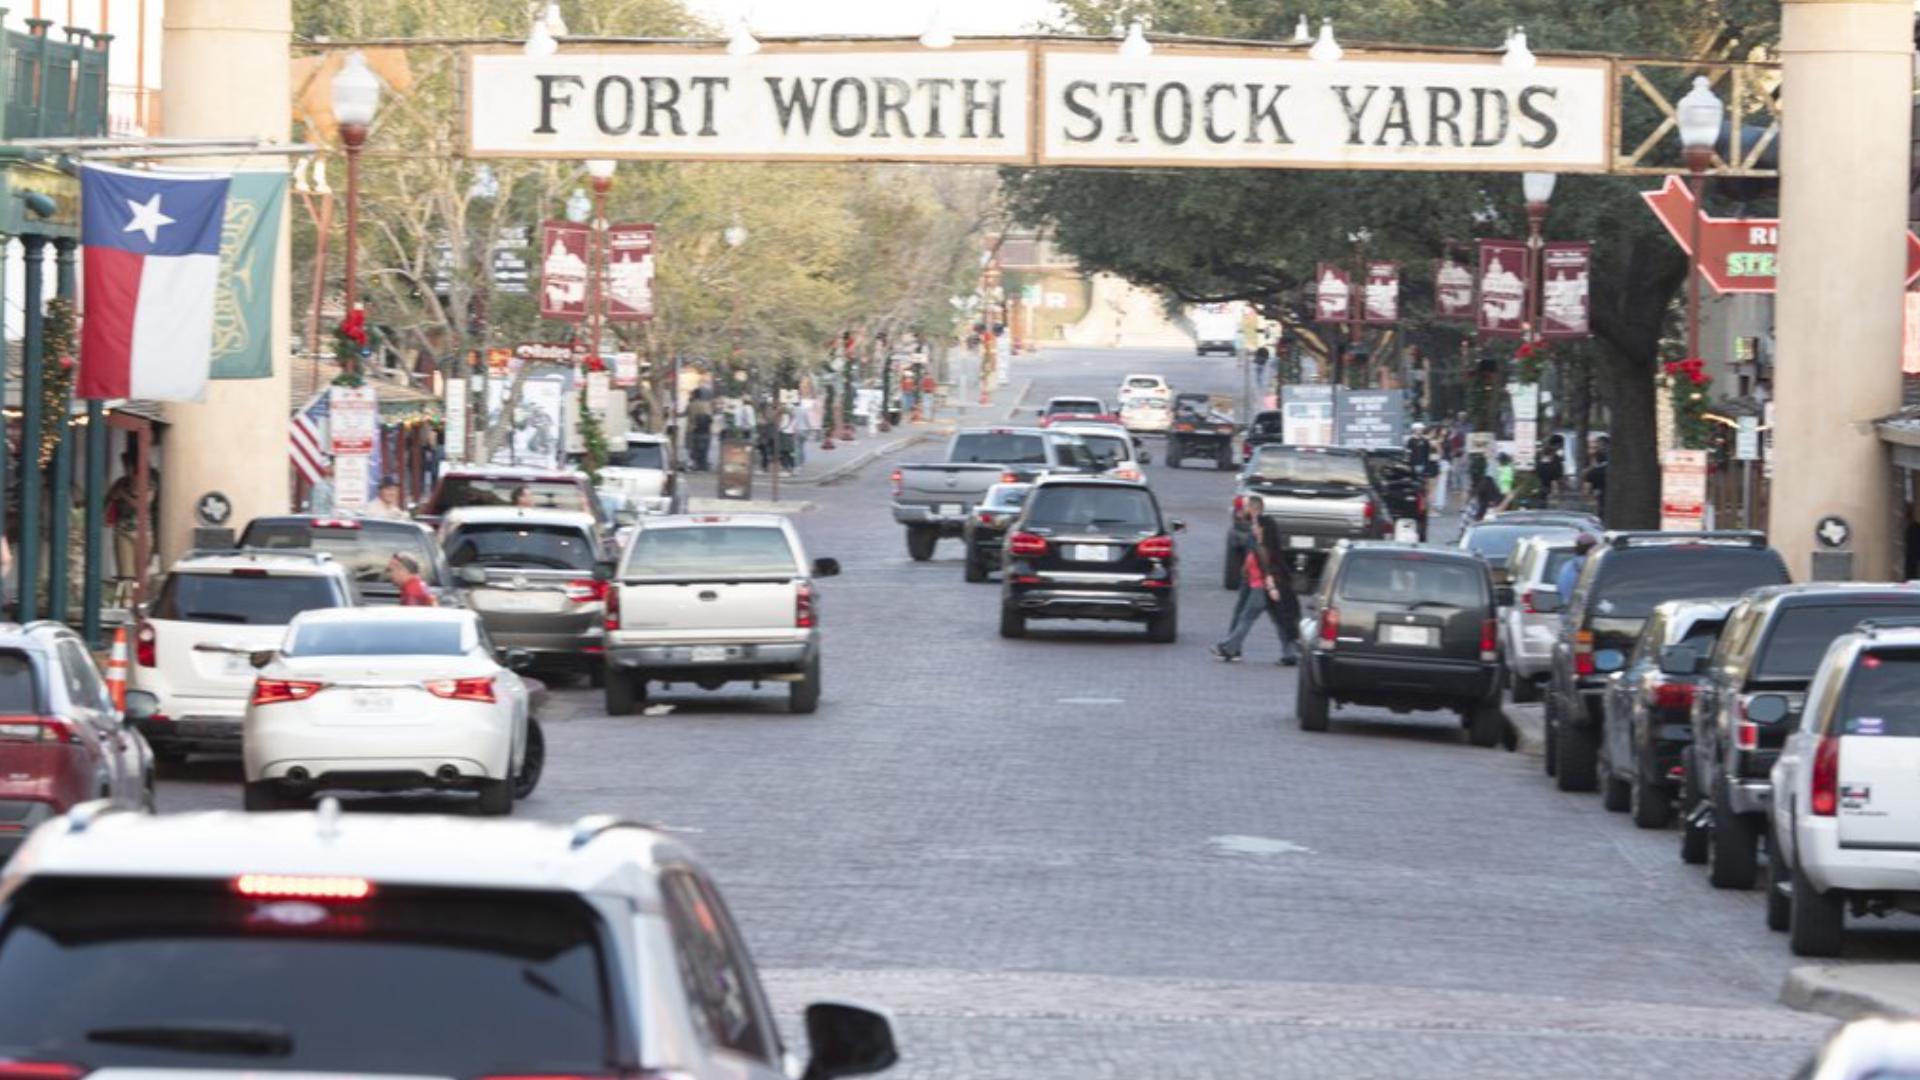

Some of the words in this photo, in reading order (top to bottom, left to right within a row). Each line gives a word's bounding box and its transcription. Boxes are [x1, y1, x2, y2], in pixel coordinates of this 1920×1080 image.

[532, 74, 730, 138] FORT
[763, 76, 1006, 139] WORTH
[1062, 79, 1294, 144] STOCK
[1331, 84, 1560, 150] YARDS
[1727, 252, 1779, 277] STE
